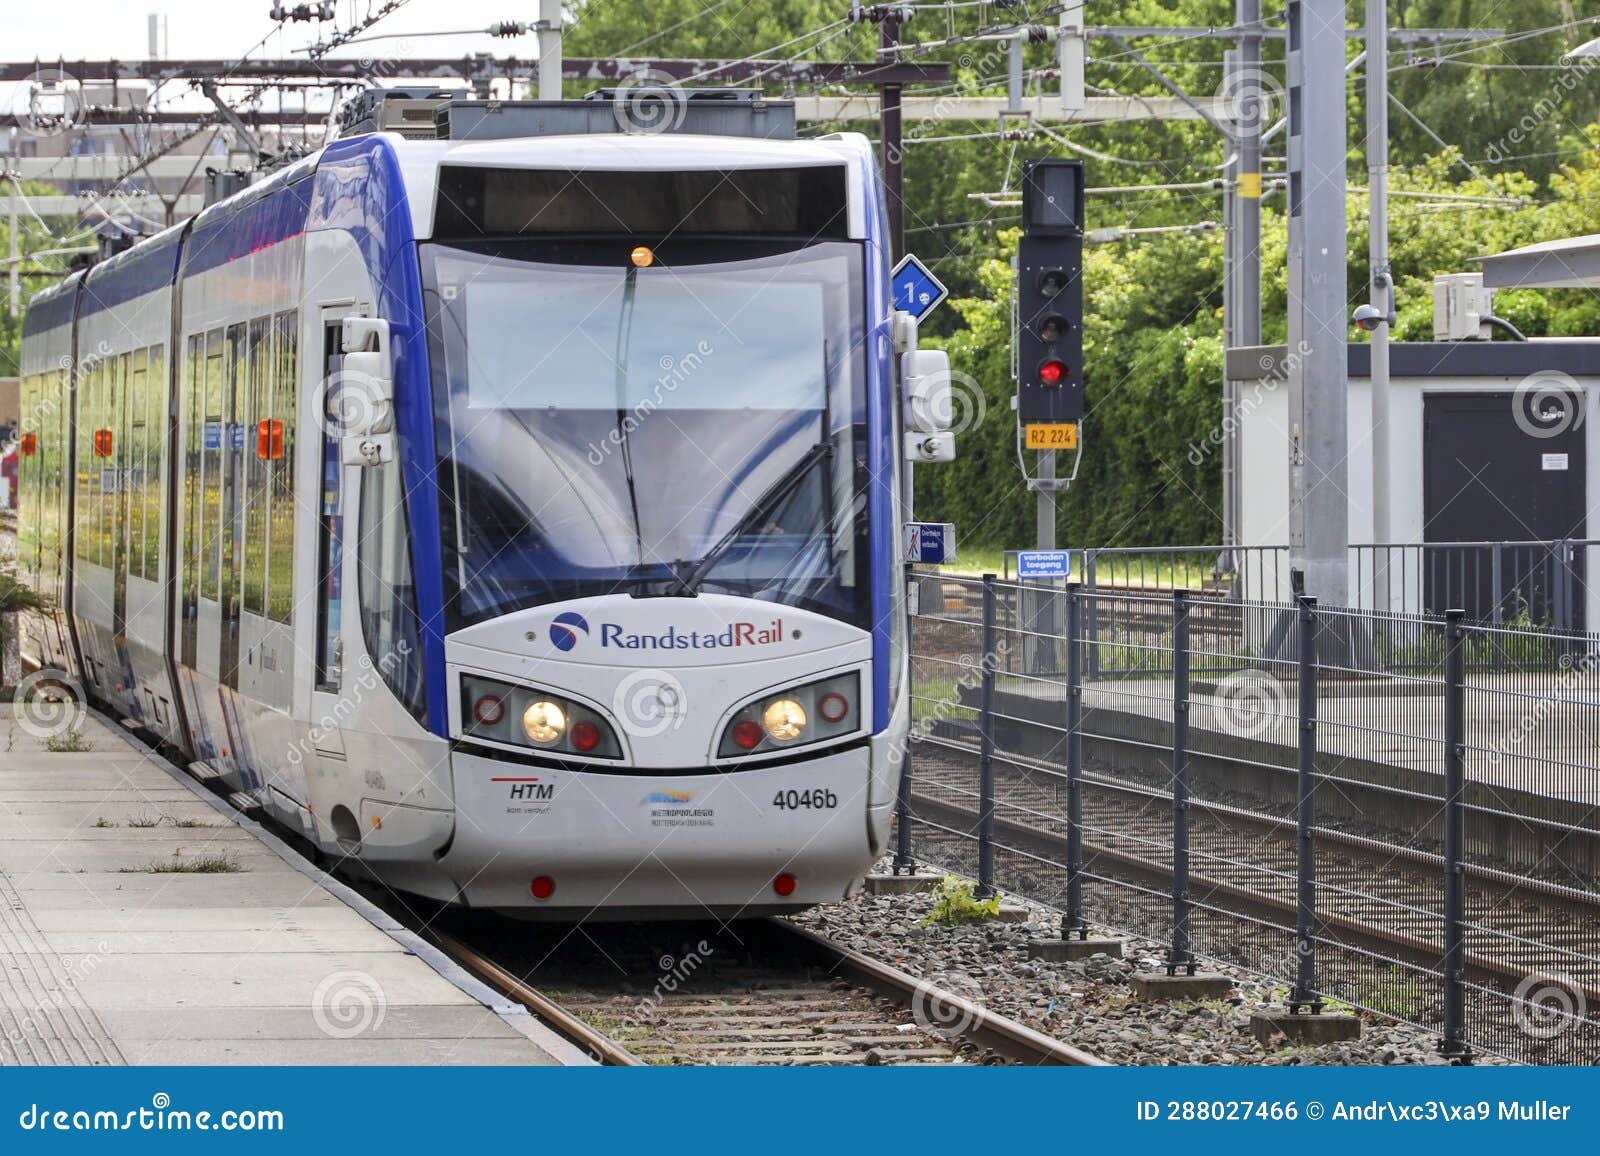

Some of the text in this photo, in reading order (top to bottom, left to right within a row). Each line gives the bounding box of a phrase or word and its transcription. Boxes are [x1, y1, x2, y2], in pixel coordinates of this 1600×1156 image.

[903, 282, 914, 304] 1
[1031, 430, 1071, 443] R2 224
[1026, 561, 1062, 569] toegang
[601, 619, 783, 649] RandstadRail
[510, 784, 554, 799] HTM
[773, 788, 837, 810] 4046b
